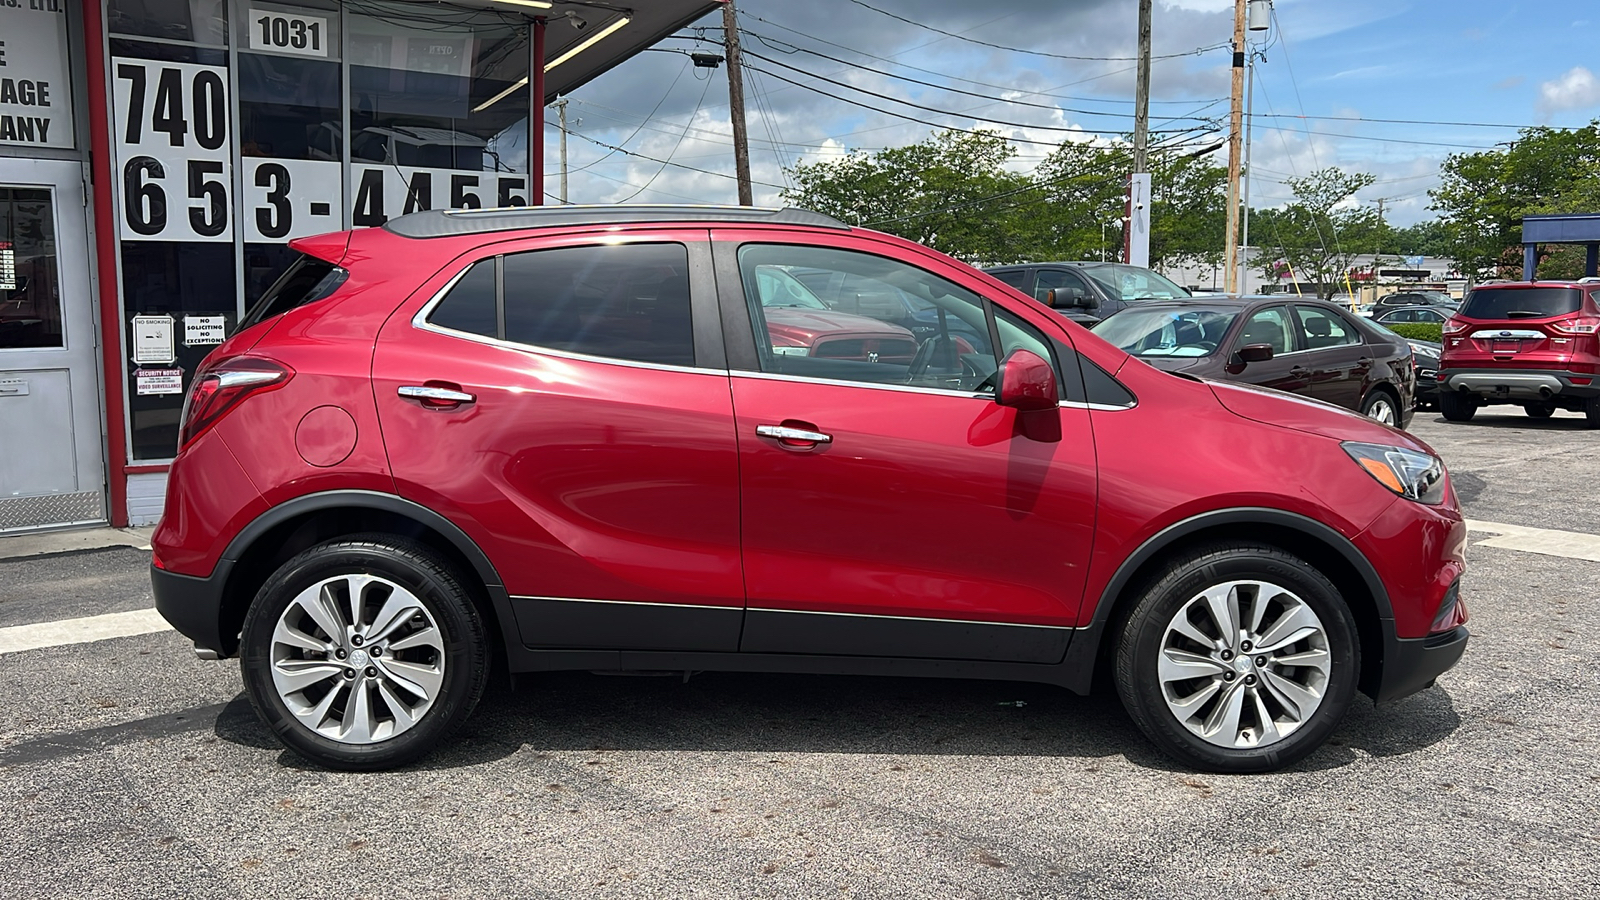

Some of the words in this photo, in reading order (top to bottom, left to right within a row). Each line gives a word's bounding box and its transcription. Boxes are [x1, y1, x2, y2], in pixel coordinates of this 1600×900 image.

[258, 16, 320, 50] 1031
[1, 78, 51, 107] AGE
[118, 63, 226, 150] 740
[0, 115, 51, 143] ANY
